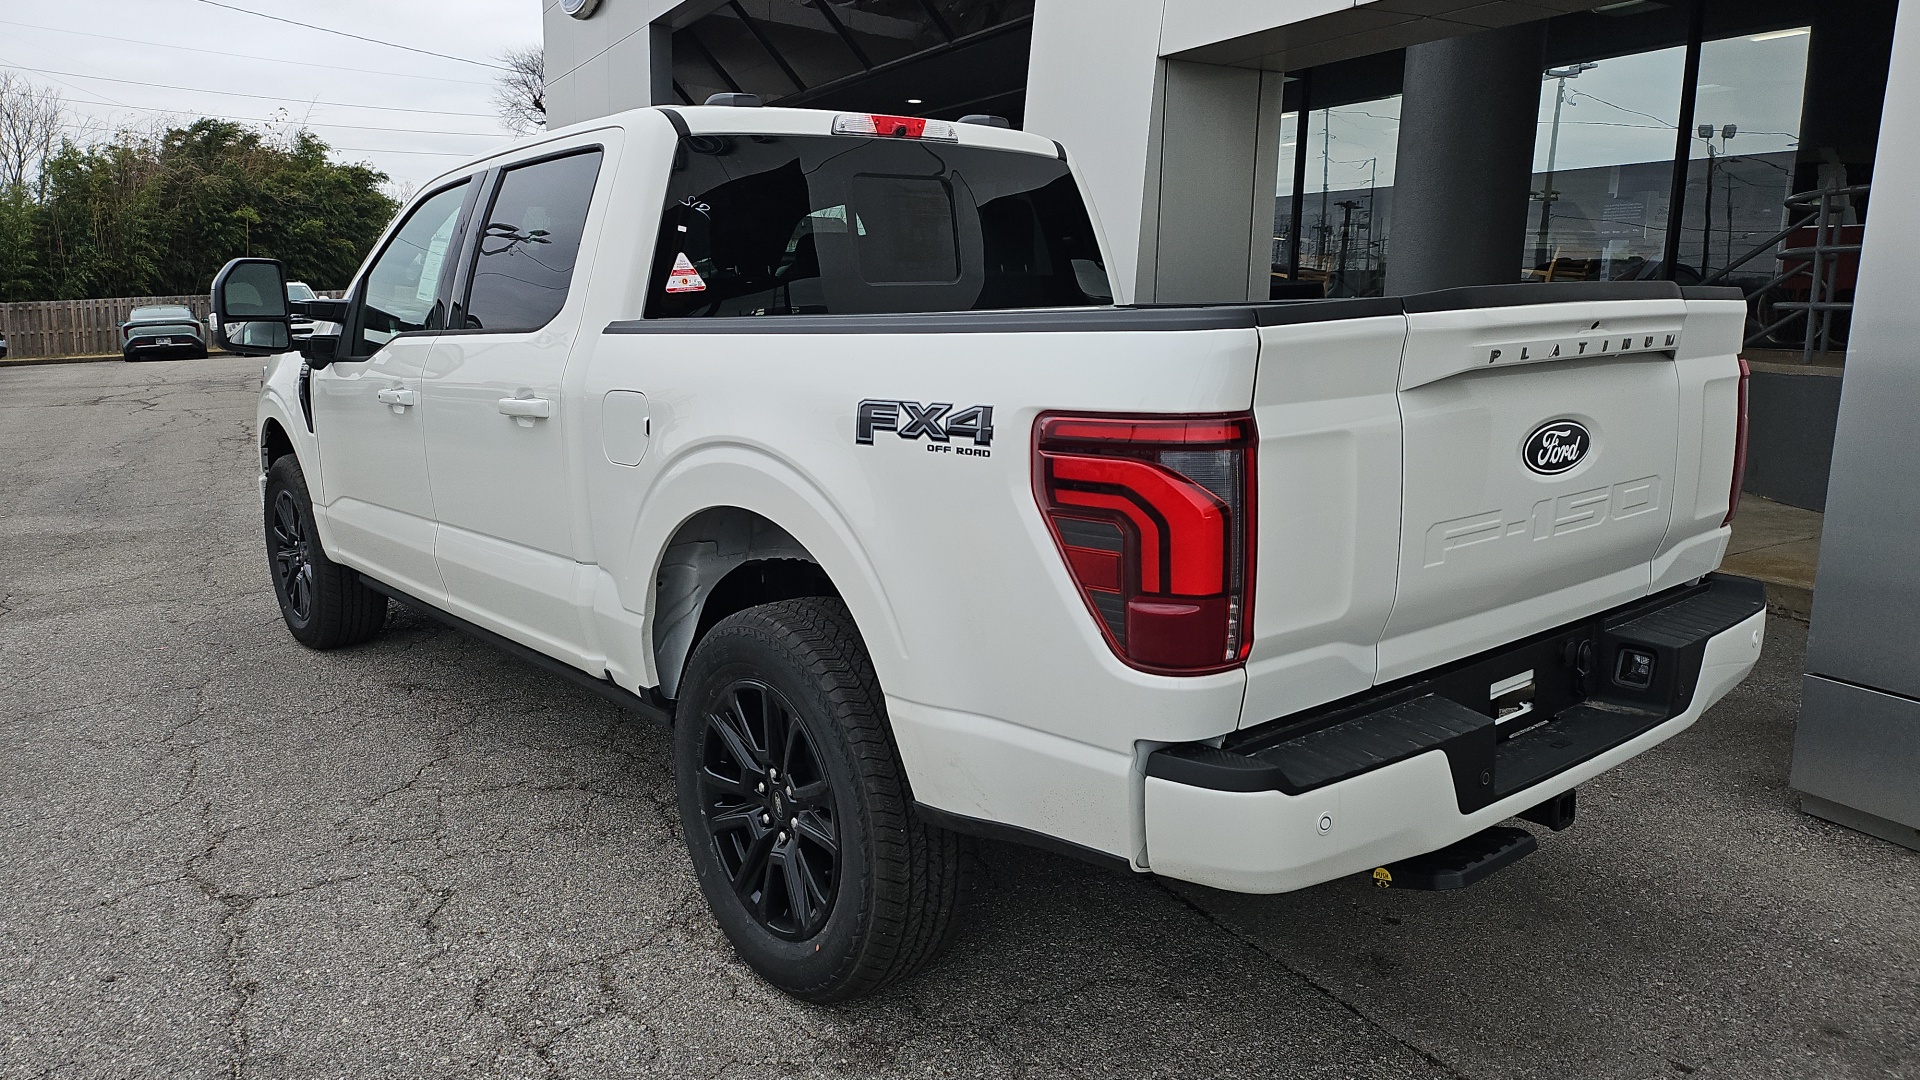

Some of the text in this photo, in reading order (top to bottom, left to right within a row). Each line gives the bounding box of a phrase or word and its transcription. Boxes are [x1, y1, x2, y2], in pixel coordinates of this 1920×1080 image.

[1488, 334, 1676, 364] PLATINUM
[855, 398, 994, 446] FX4
[926, 444, 991, 458] OFF ROAD
[1536, 429, 1582, 466] Ford
[1423, 474, 1662, 569] F-150
